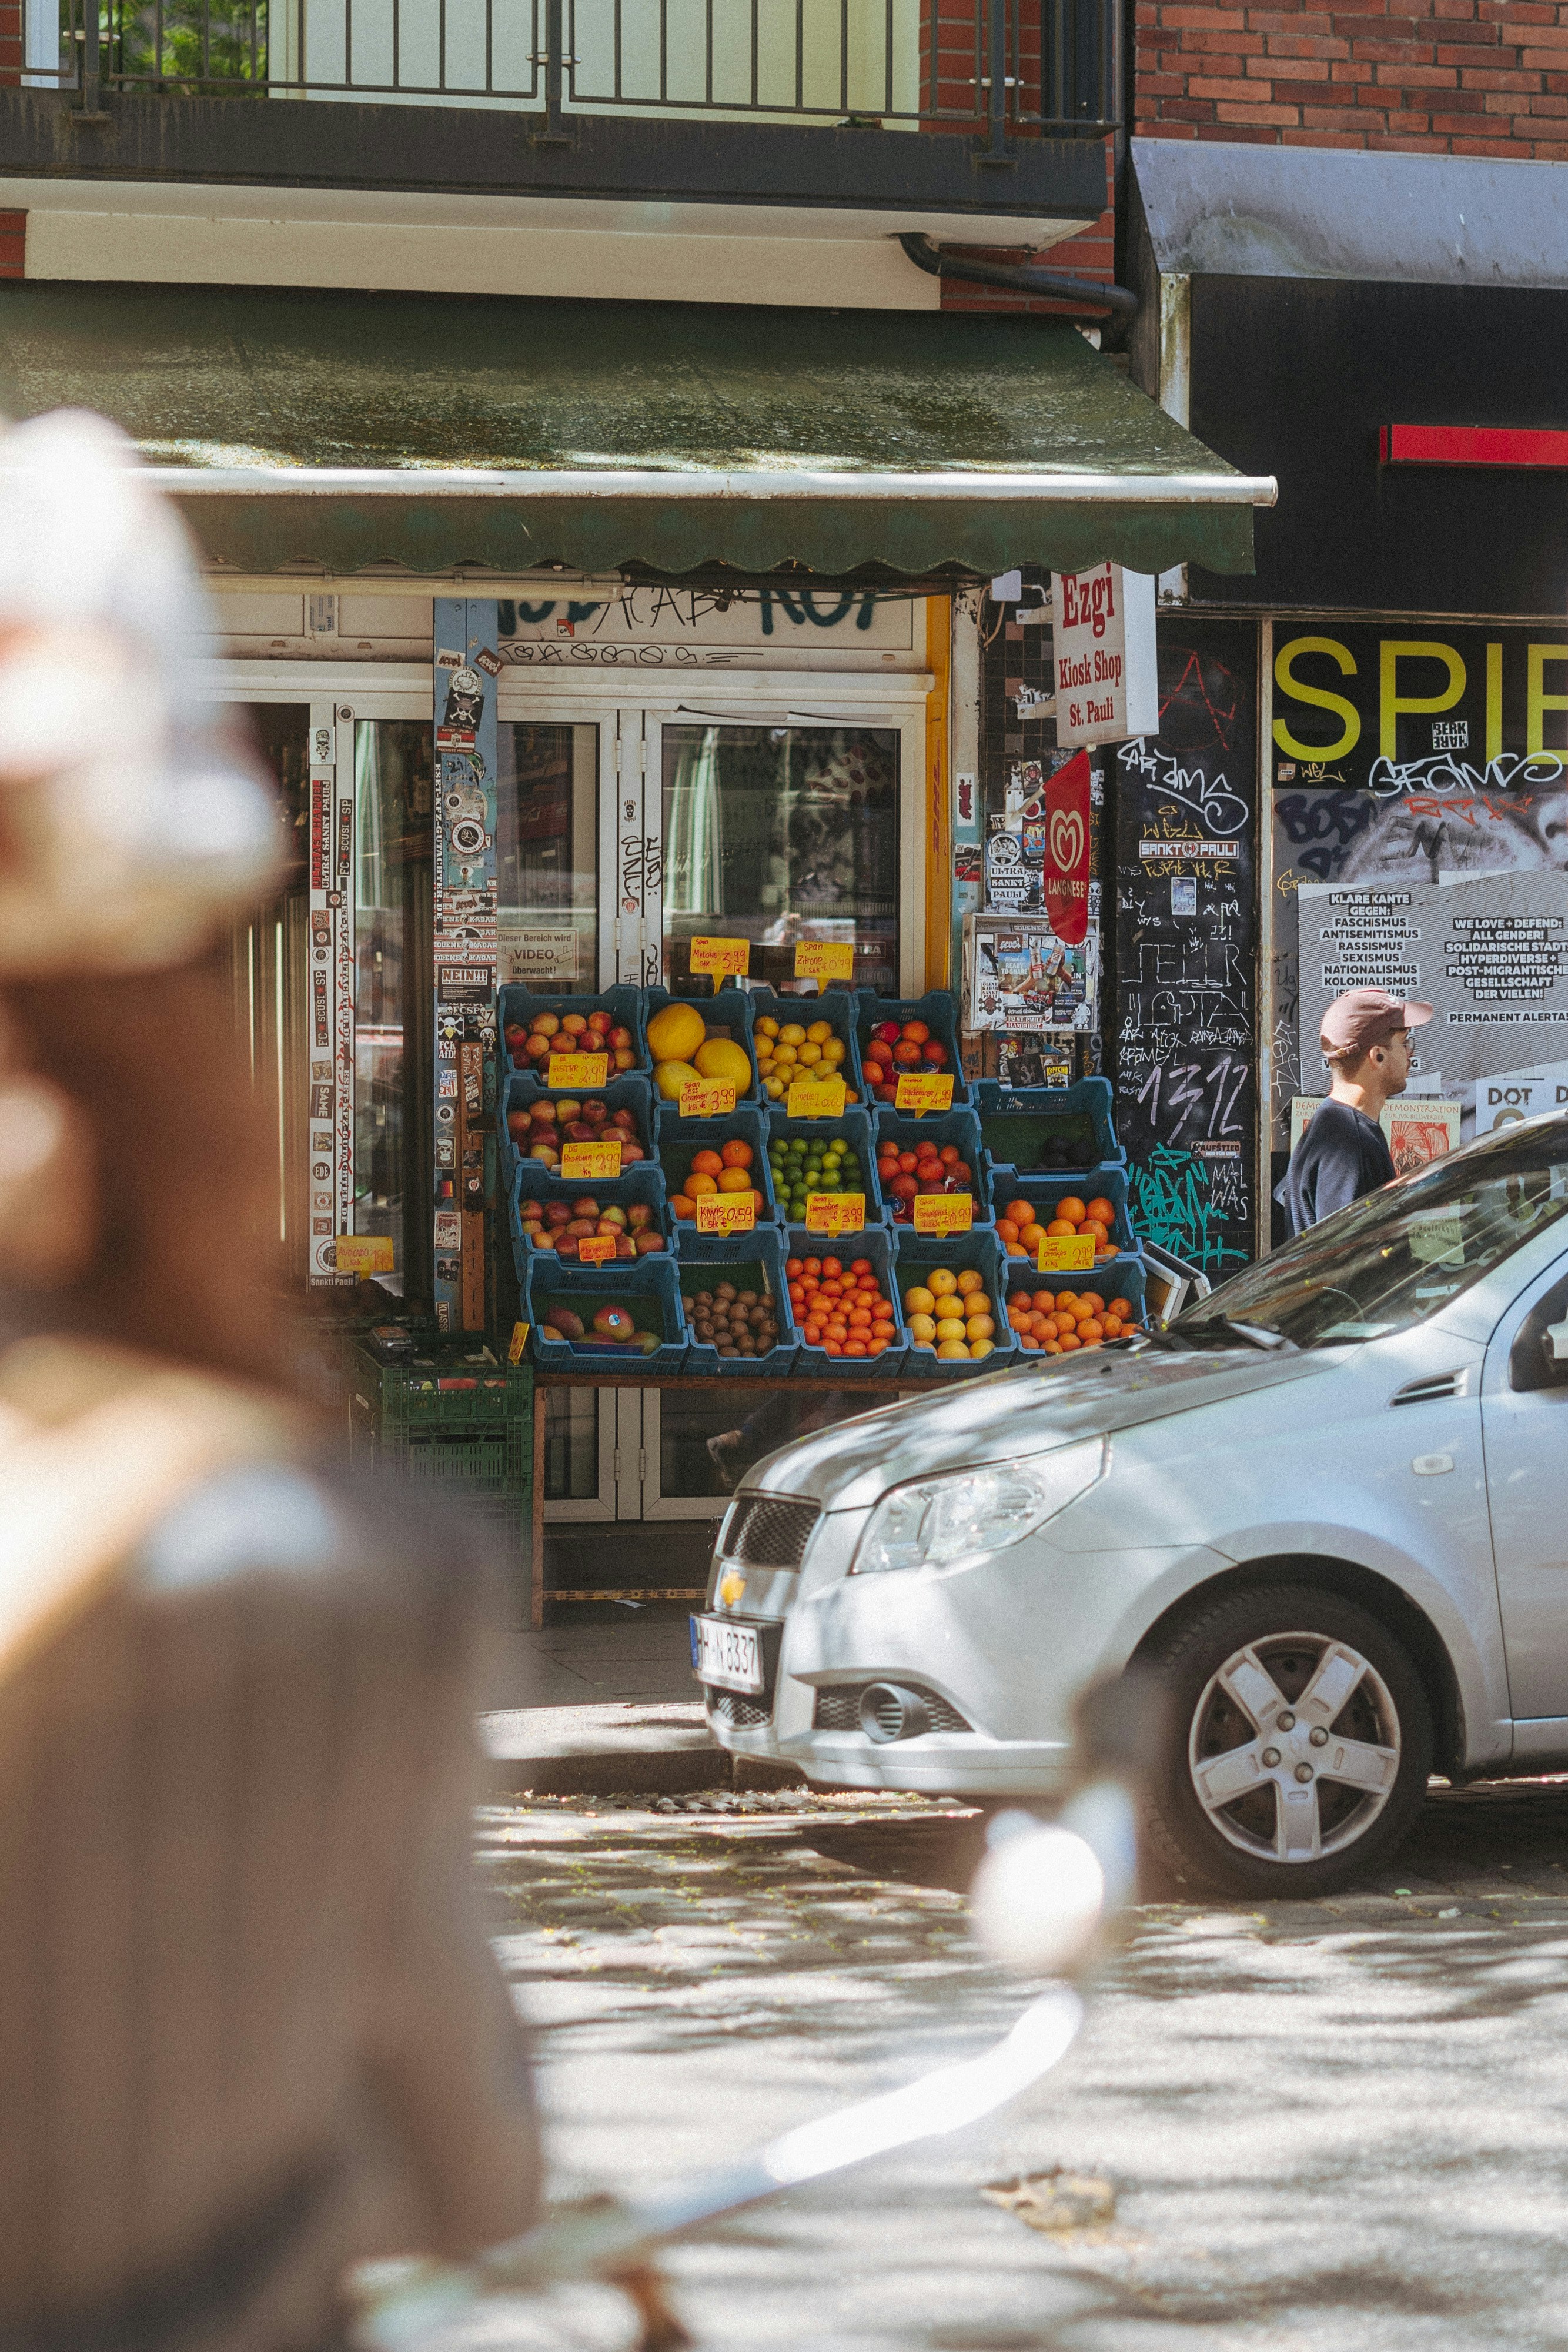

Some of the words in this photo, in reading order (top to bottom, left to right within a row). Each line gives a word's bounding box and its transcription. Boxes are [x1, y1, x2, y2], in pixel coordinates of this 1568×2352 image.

[1061, 562, 1115, 639] Ezgi
[1059, 654, 1092, 690] Kiosk
[1094, 649, 1122, 687] Shop
[1069, 703, 1084, 727] St.
[1086, 696, 1114, 724] Pauli
[322, 781, 330, 811] PAULI
[342, 800, 352, 814] SP
[322, 816, 330, 850] SANKT
[341, 824, 350, 851] SCUSI
[1141, 843, 1182, 854] SANKT
[1199, 843, 1237, 854] PAULI
[340, 861, 350, 875] FC
[1048, 878, 1084, 898] LANGNESE
[1331, 894, 1370, 904] KLARE
[1372, 894, 1410, 904] KANTE
[1350, 906, 1391, 916] GEGEN:
[1335, 918, 1406, 927] FASCHISMUS
[1455, 919, 1473, 929] WE
[1475, 918, 1505, 928] LOVE
[1514, 918, 1562, 928] DEFEND:
[498, 934, 521, 942] Dieser
[524, 934, 552, 942] Bereich
[554, 934, 571, 942] wird
[1322, 930, 1419, 939] ANTISEMITISMUS
[1472, 930, 1494, 940] ALL
[1495, 930, 1544, 940] GENDER!
[804, 942, 823, 951] Span
[1338, 942, 1403, 950] RASSISMUS
[1446, 943, 1530, 953] SOLIDARISCHE
[514, 948, 554, 960] VIDEO
[1342, 953, 1399, 962] SEXISMUS
[1460, 954, 1549, 964] HYPERDIVERSE
[512, 965, 556, 974] überwacht!
[1324, 965, 1417, 974] NATIONALISMUS
[1448, 965, 1568, 976] POST-MIGRANTISCHE
[315, 971, 326, 986] SP
[443, 970, 487, 981] NEIN!!!
[1324, 977, 1417, 986] KOLONIALISMUS
[1466, 977, 1552, 987] GESELLSCHAFT
[1475, 989, 1498, 999] DER
[1499, 988, 1543, 998] VIELEN!
[316, 995, 326, 1023] SCUSI
[453, 1006, 480, 1014] FCSP
[1449, 1013, 1521, 1023] PERMANENT
[317, 1032, 329, 1046] FC
[439, 1040, 456, 1050] FCK
[438, 1050, 456, 1059] AfD!
[319, 1087, 330, 1117] SAME
[1488, 1088, 1533, 1106] DOT
[1384, 1103, 1459, 1114] DEMONSTRATION
[315, 1166, 329, 1177] EDE
[700, 1205, 724, 1219] Kiwis
[335, 1278, 353, 1287] Pauli
